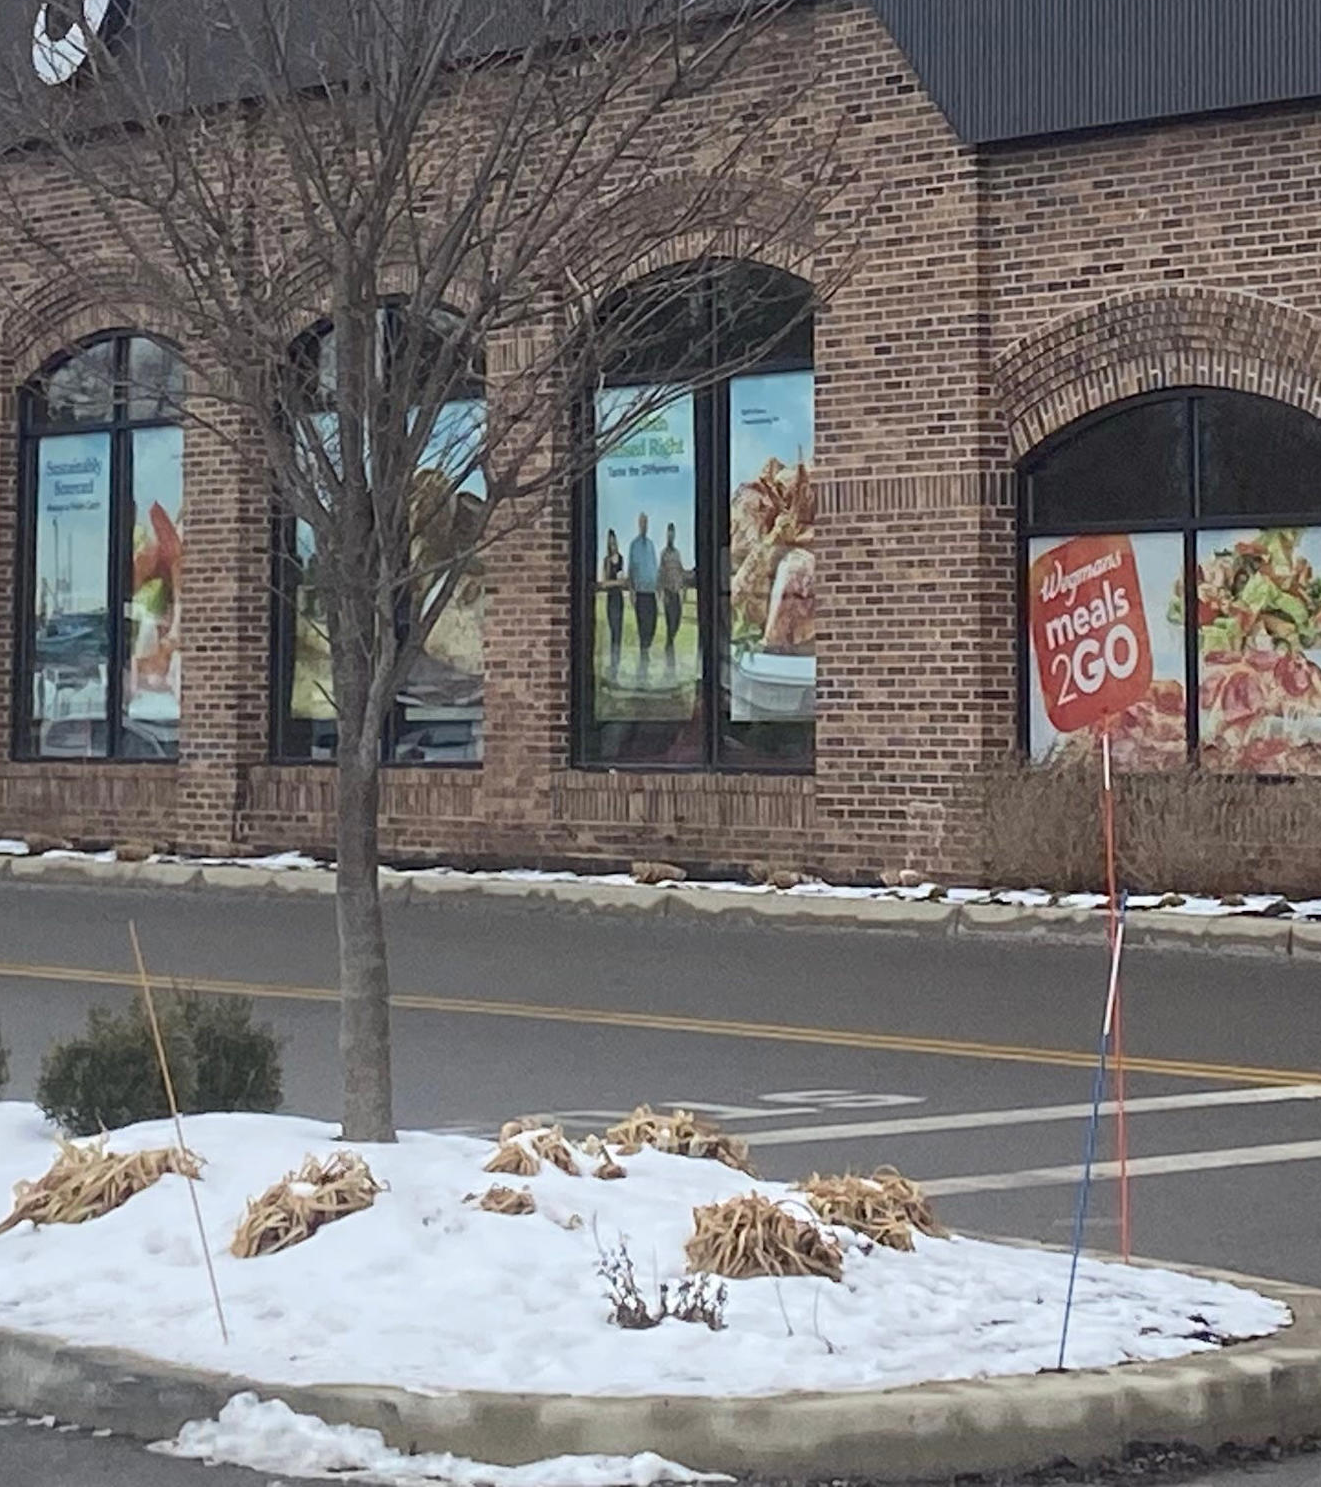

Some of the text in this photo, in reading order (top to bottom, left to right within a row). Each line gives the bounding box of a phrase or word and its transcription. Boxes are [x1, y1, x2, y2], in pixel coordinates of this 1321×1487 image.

[1040, 550, 1122, 607] Wegmans
[1046, 580, 1130, 650] meals
[1051, 623, 1139, 706] 2GO
